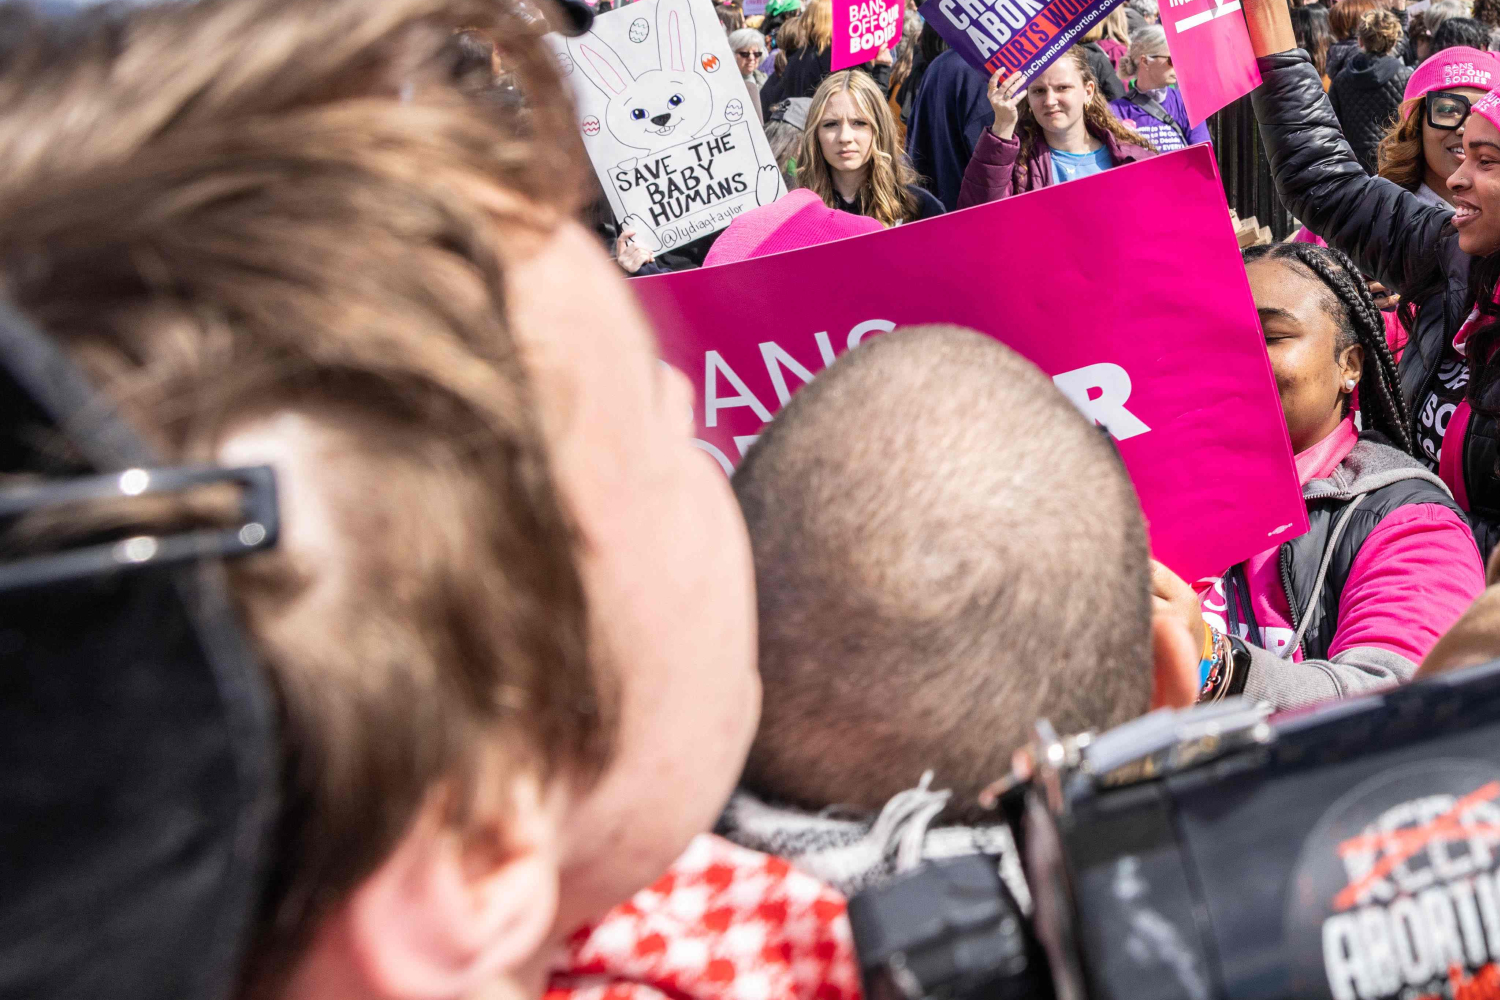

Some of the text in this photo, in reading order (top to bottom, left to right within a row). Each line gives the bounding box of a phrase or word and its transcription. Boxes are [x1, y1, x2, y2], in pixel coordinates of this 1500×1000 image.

[849, 4, 899, 37] OFF OUR
[850, 21, 896, 54] BODIES
[990, 21, 1050, 80] HURTS
[1445, 75, 1487, 85] BODIES
[1466, 69, 1492, 80] OUR
[615, 133, 736, 192] SAVE THE
[646, 158, 714, 205] BABY
[648, 173, 748, 227] HUMANS
